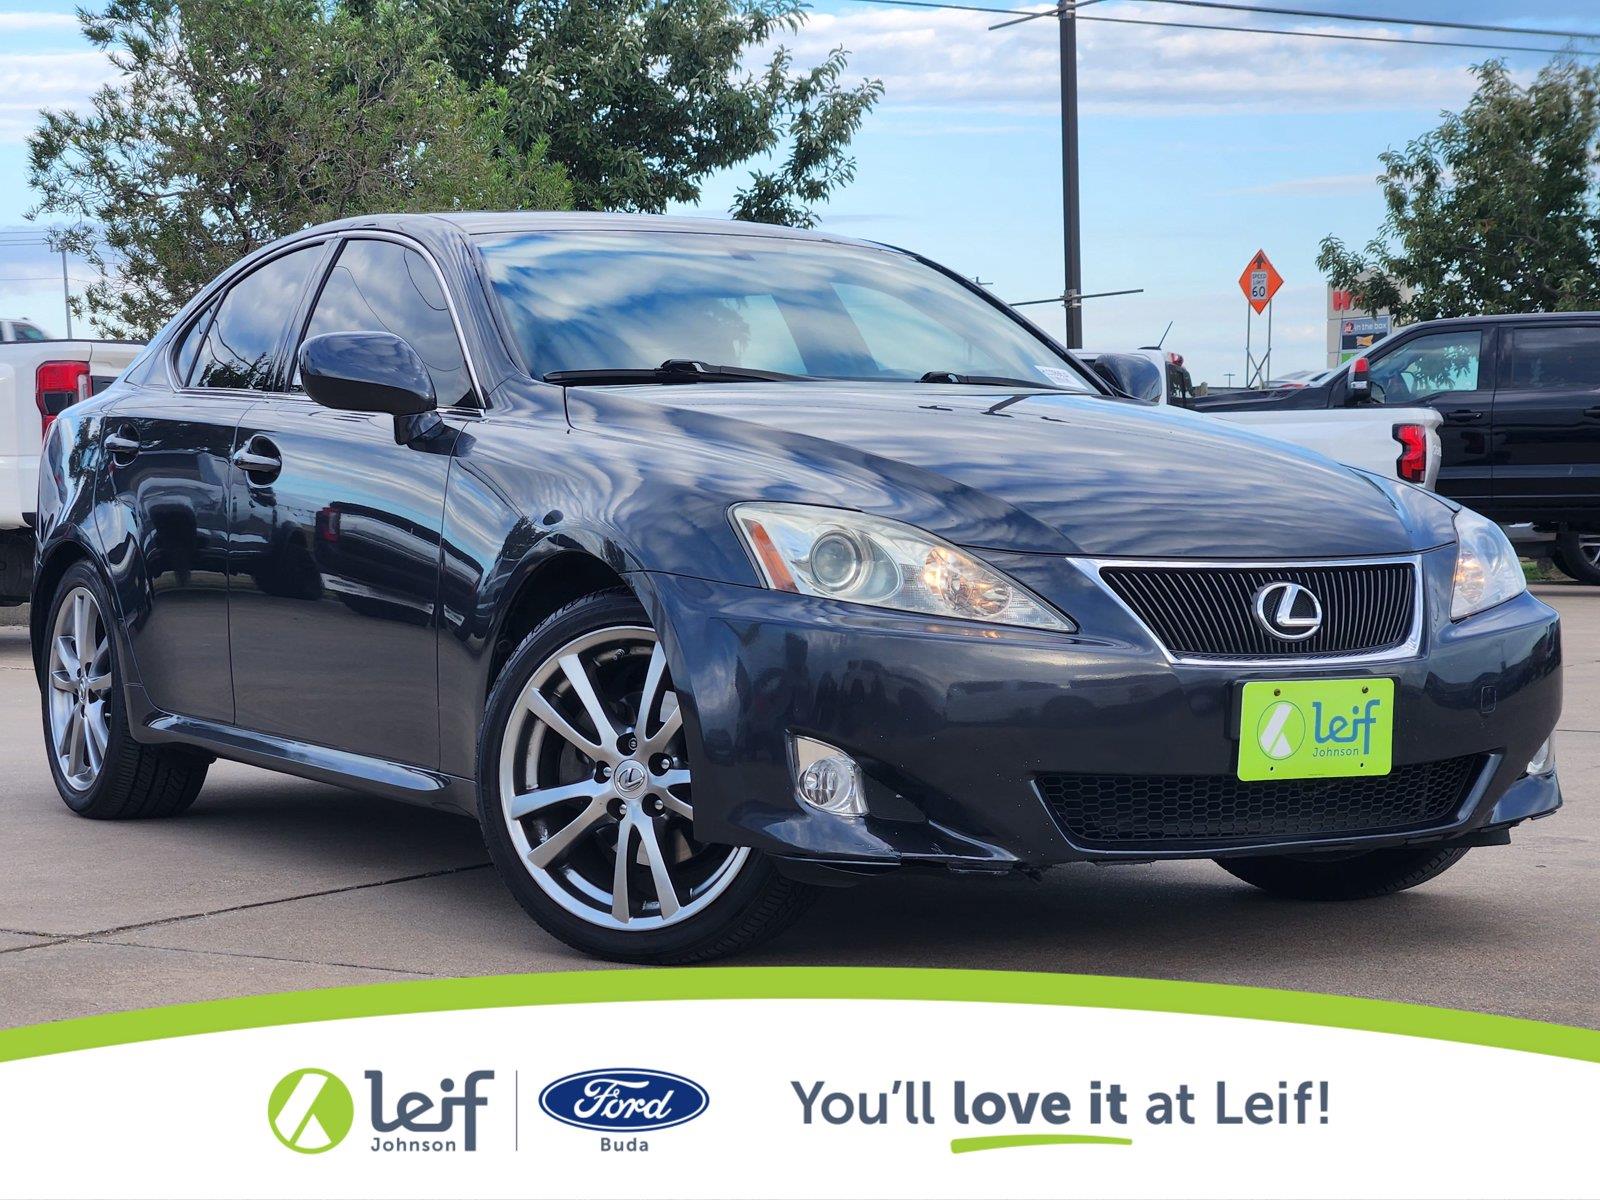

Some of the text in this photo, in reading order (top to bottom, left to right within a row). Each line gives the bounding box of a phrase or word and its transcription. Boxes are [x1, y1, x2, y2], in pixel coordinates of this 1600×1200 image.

[1252, 286, 1266, 297] 60
[1361, 322, 1373, 331] the
[1374, 321, 1387, 330] box
[1312, 747, 1359, 758] Johnson
